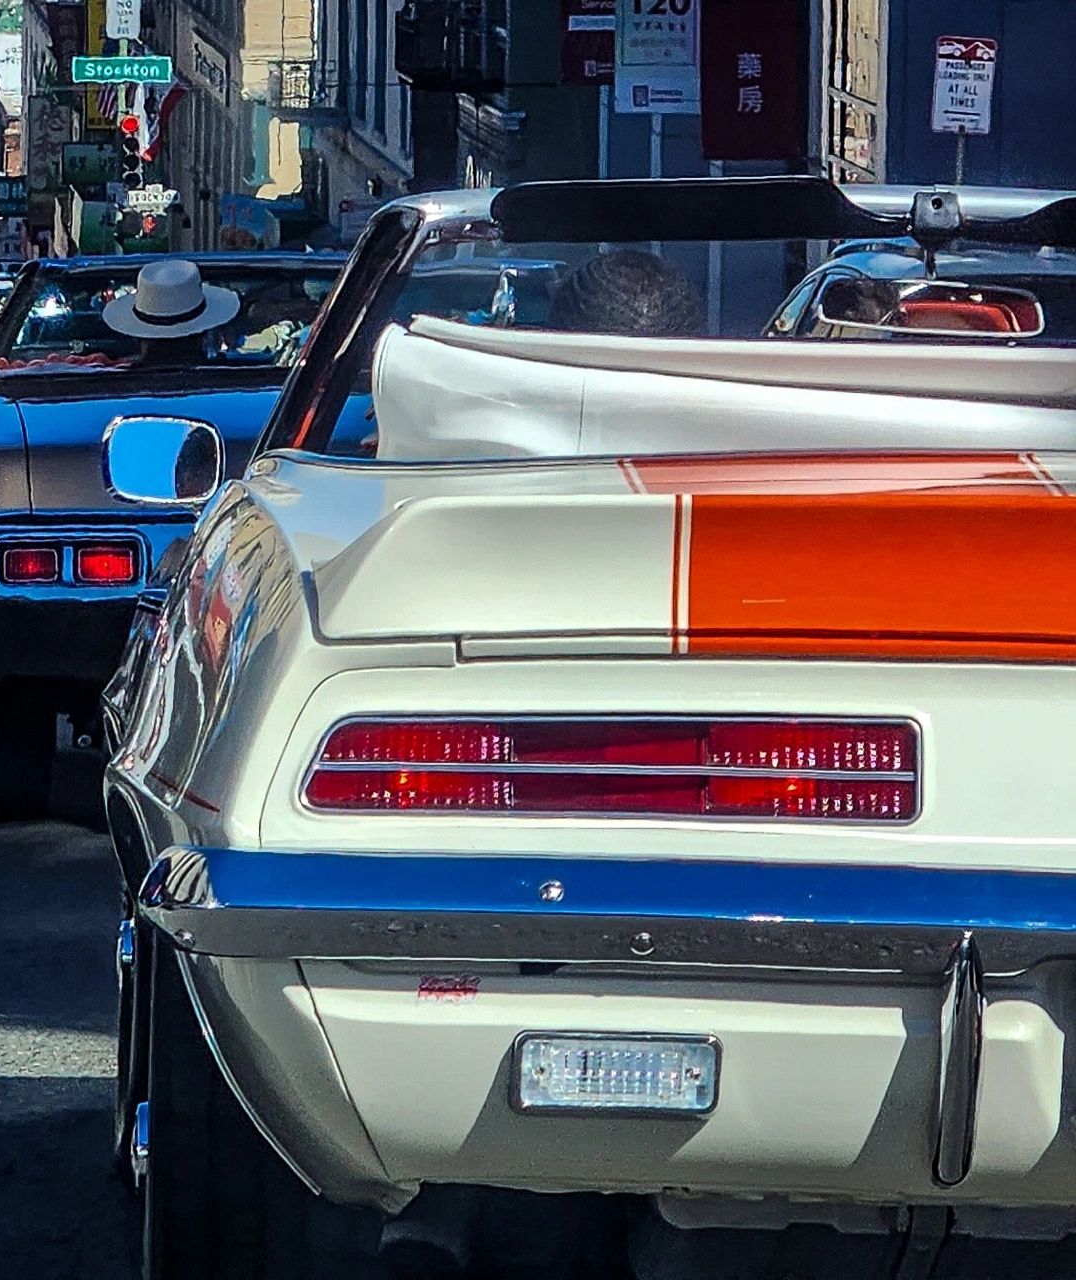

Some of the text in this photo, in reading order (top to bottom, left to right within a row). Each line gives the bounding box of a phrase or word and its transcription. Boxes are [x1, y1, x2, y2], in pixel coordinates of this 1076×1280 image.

[85, 63, 160, 77] Stockton
[946, 62, 986, 70] PASSGER
[737, 52, 763, 113] 藥房
[948, 84, 977, 95] AT ALL
